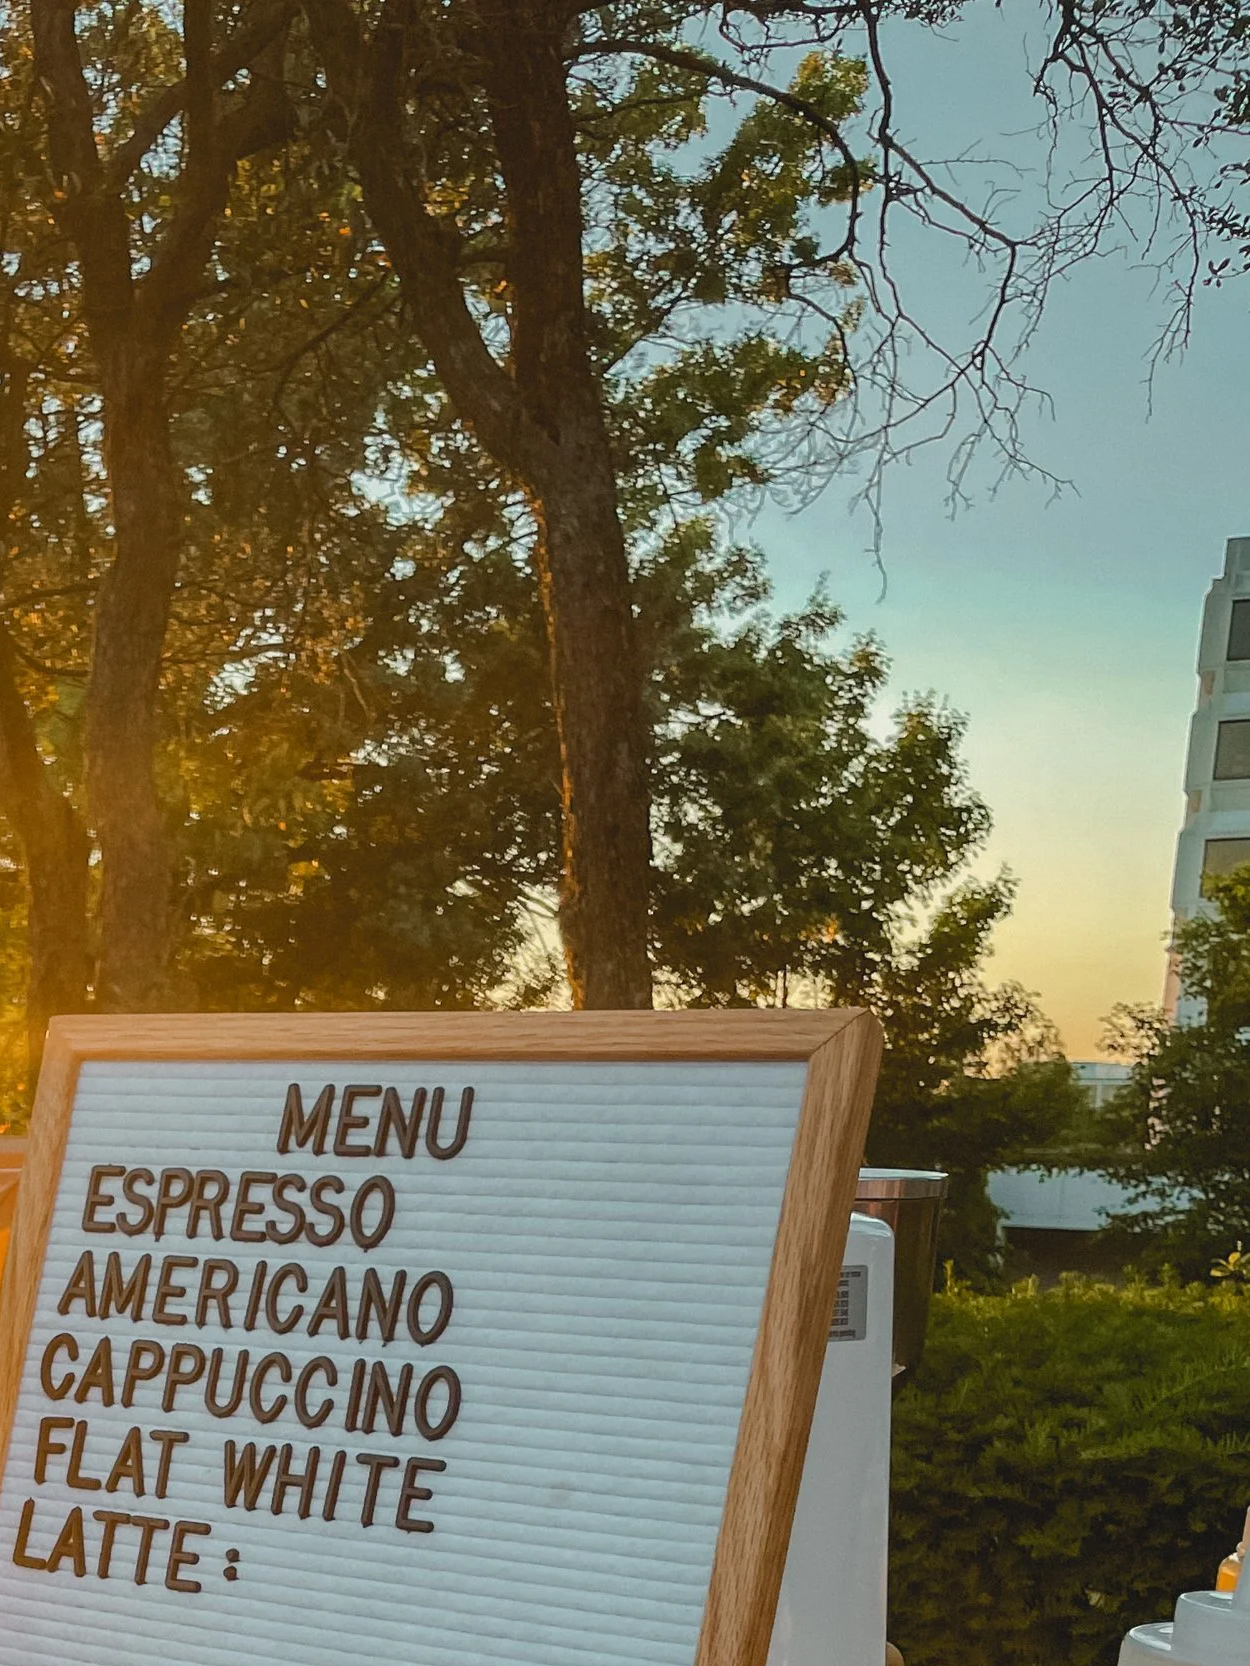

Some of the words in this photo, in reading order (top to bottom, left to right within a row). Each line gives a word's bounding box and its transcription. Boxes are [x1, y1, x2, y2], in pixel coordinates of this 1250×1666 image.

[276, 1083, 475, 1160] MENU
[81, 1164, 396, 1251] ESPRESSO
[57, 1250, 454, 1347] AMERICANO
[40, 1332, 462, 1441] CAPPUCCINO
[33, 1416, 190, 1499] FLAT
[223, 1439, 447, 1533] WHITE
[12, 1497, 240, 1593] LATTE:
